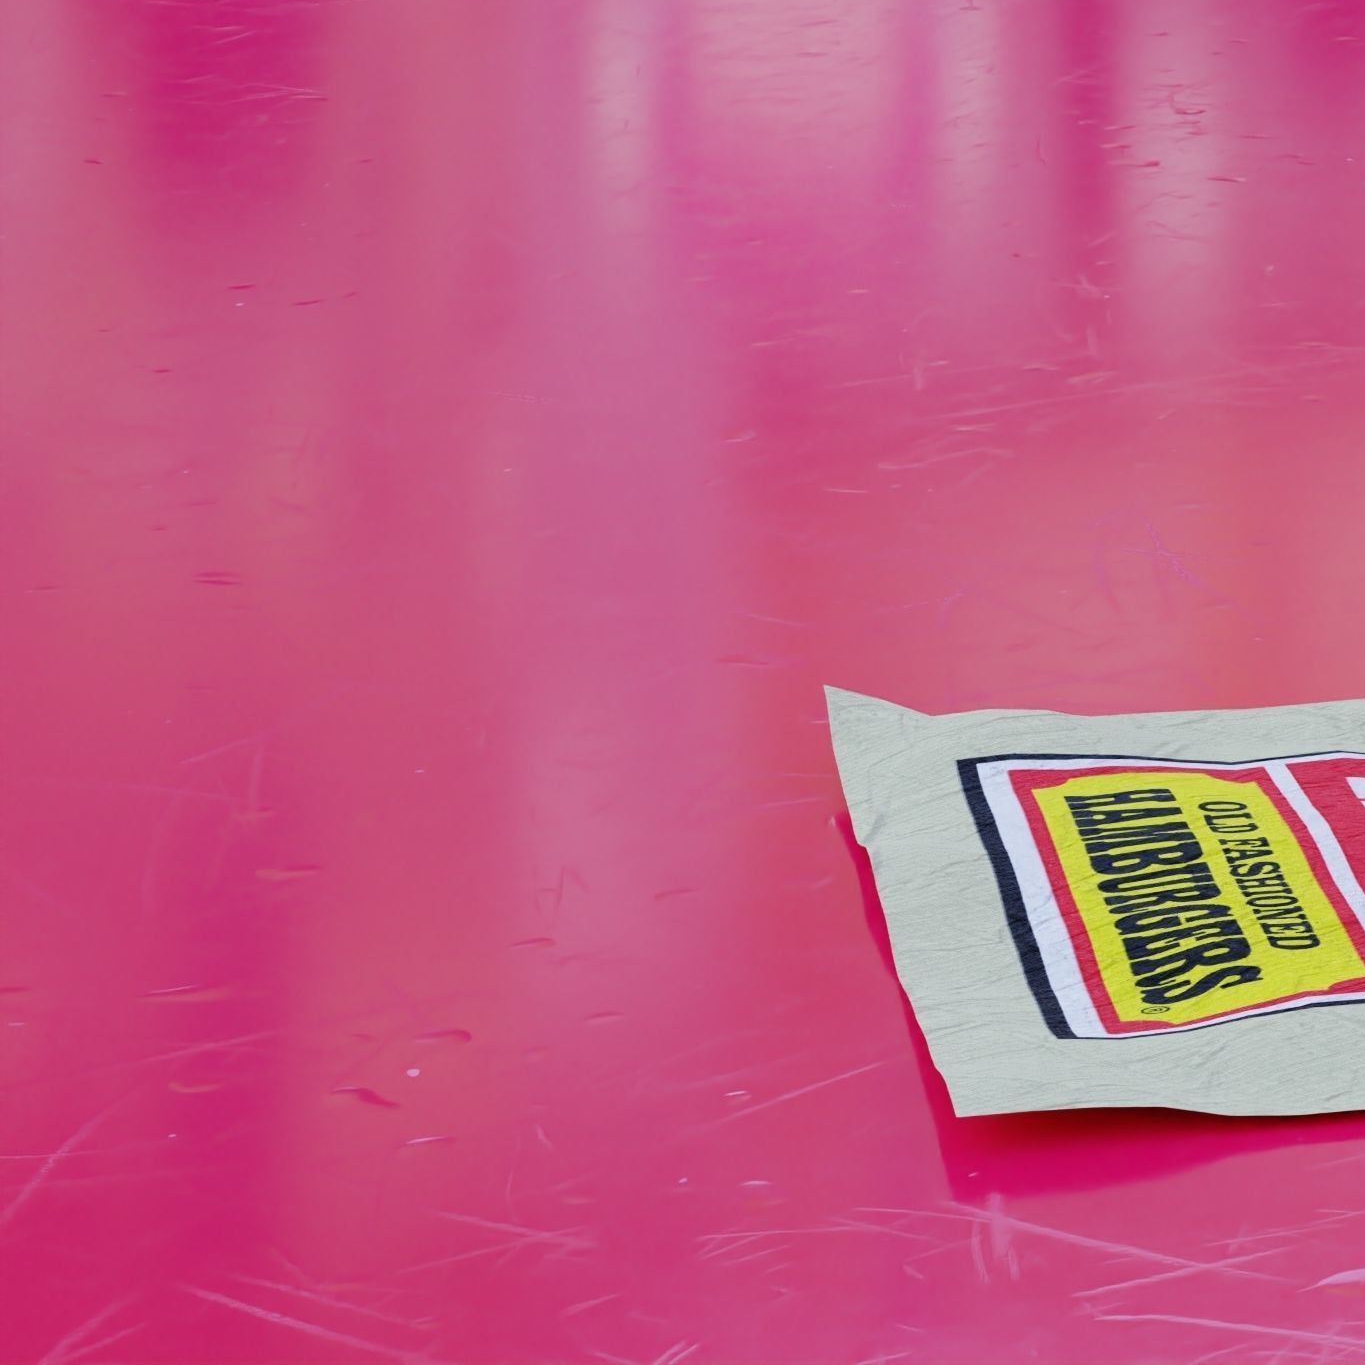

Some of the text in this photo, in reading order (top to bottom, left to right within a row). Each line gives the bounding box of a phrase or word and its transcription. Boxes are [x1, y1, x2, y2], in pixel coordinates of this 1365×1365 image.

[1063, 788, 1264, 1005] HAMBURGERS
[1198, 800, 1321, 951] OLD FASHIONED
